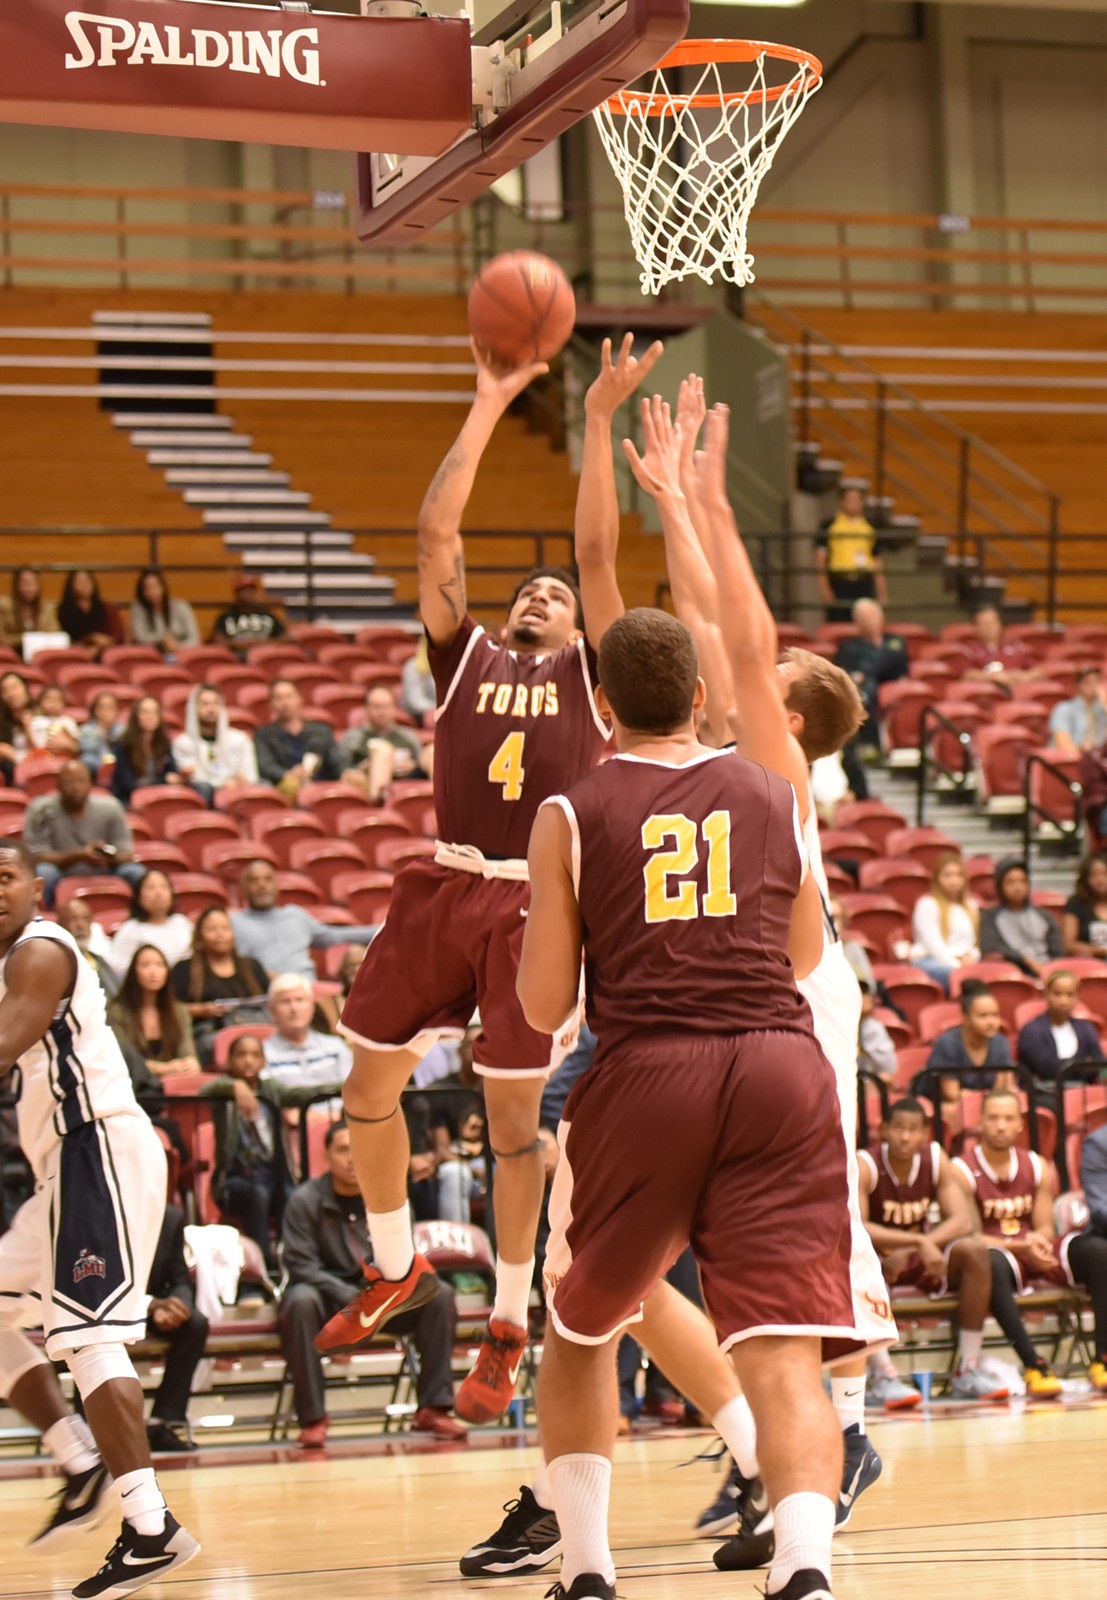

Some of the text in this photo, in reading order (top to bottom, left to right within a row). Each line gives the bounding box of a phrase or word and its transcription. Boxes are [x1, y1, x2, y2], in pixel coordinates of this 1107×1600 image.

[64, 11, 324, 86] SPALDING
[476, 681, 559, 718] TOROS
[488, 731, 525, 801] 4
[641, 809, 737, 924] 21
[73, 1261, 106, 1283] LMU
